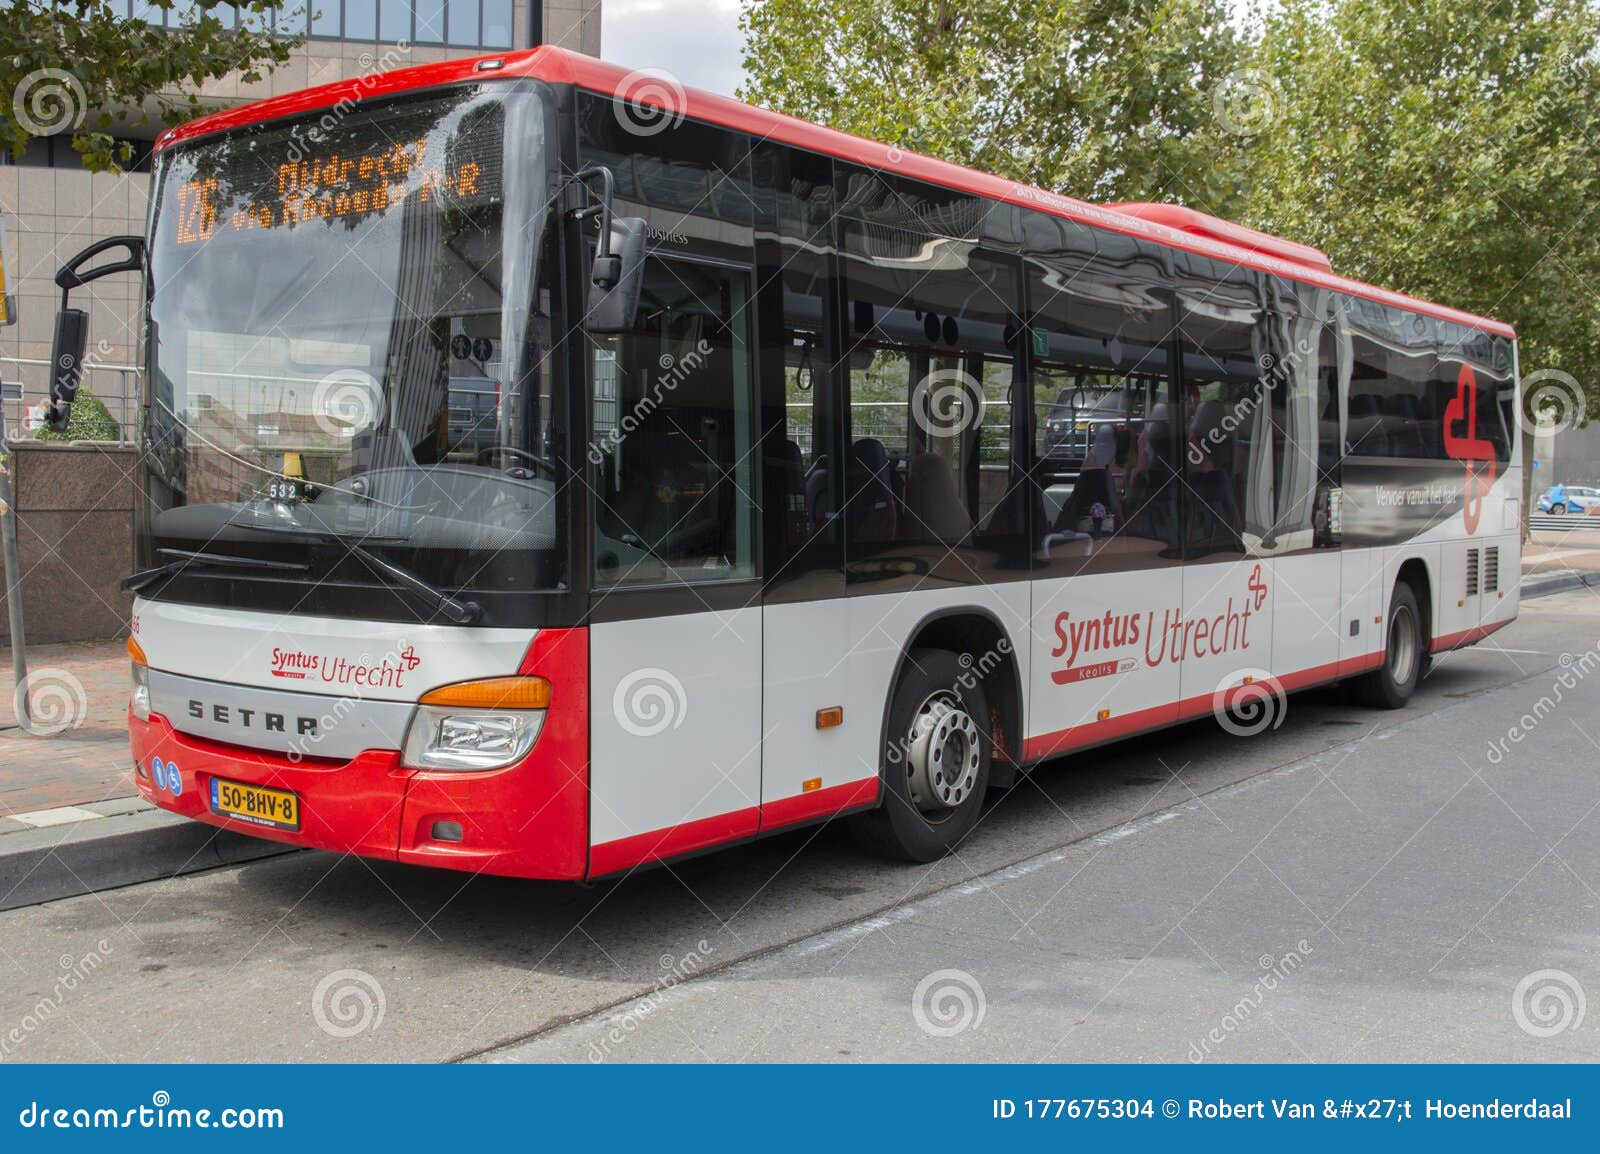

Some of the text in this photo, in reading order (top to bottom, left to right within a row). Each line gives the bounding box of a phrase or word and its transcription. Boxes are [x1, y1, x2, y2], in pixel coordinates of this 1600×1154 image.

[176, 178, 218, 245] 126
[270, 484, 296, 498] 532
[1051, 597, 1252, 669] Syntus Utrecht
[271, 648, 405, 689] Syntus Utrecht
[1080, 664, 1113, 680] Keolis
[189, 700, 318, 736] SETRA
[222, 785, 293, 820] 50-BHV-8
